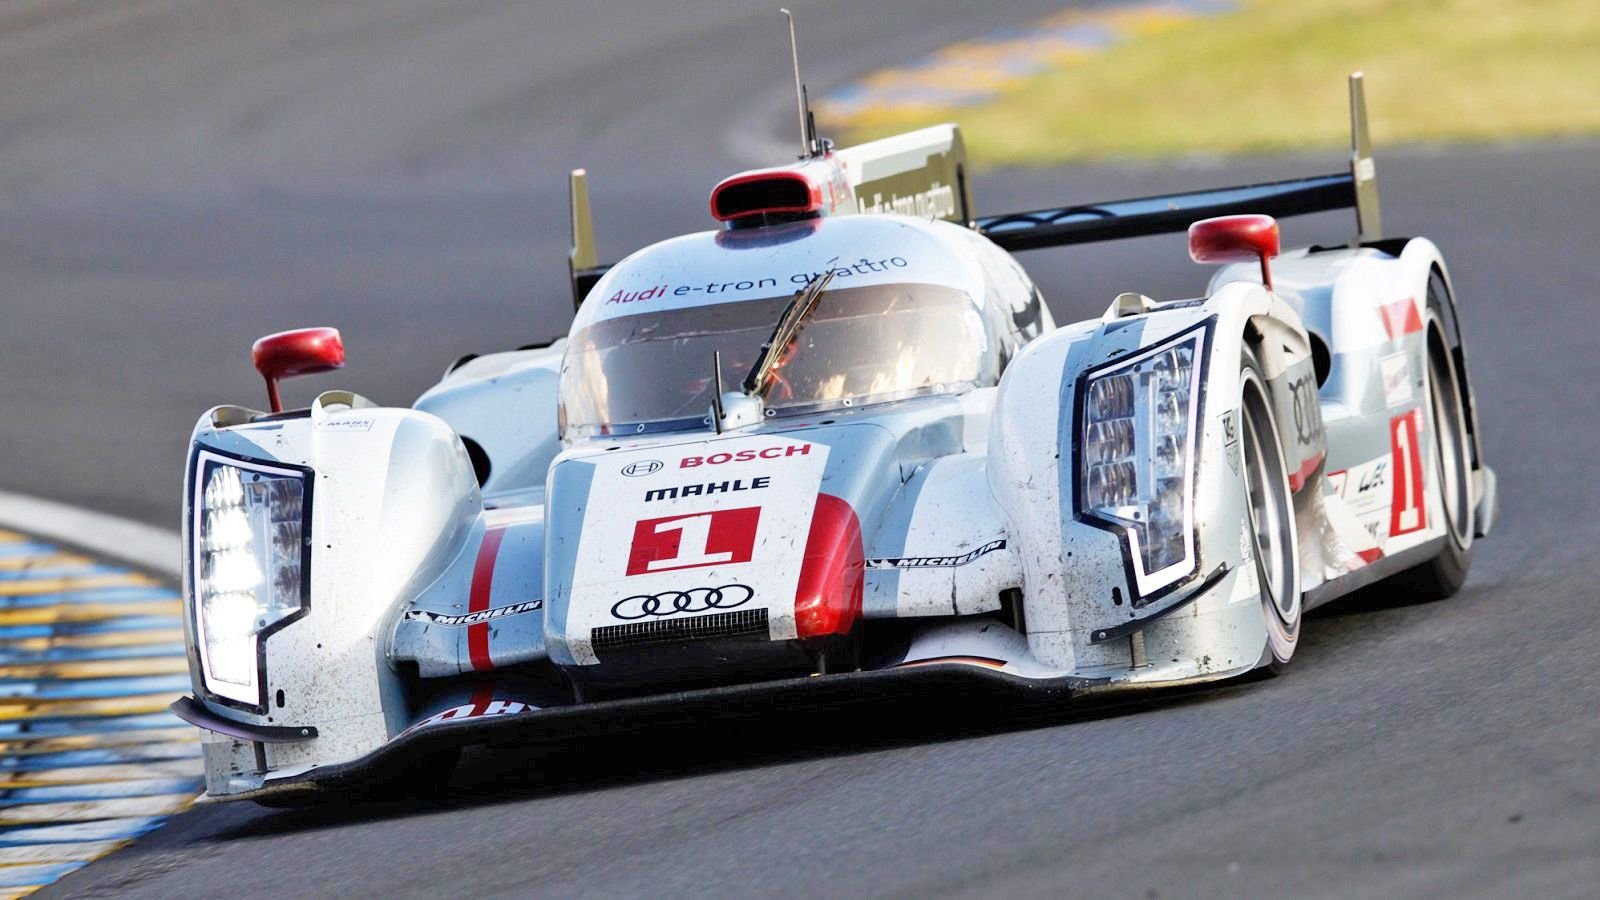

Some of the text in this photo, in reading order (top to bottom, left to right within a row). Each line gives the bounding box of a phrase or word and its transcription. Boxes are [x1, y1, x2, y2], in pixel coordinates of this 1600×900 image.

[605, 284, 668, 305] Audi
[673, 276, 777, 296] e-tron
[679, 443, 812, 469] BOSCH
[644, 476, 771, 502] MAHLE
[1396, 420, 1419, 531] 1
[647, 514, 734, 571] 1
[896, 539, 1003, 567] MICHELIN
[434, 600, 541, 625] MICHELIN
